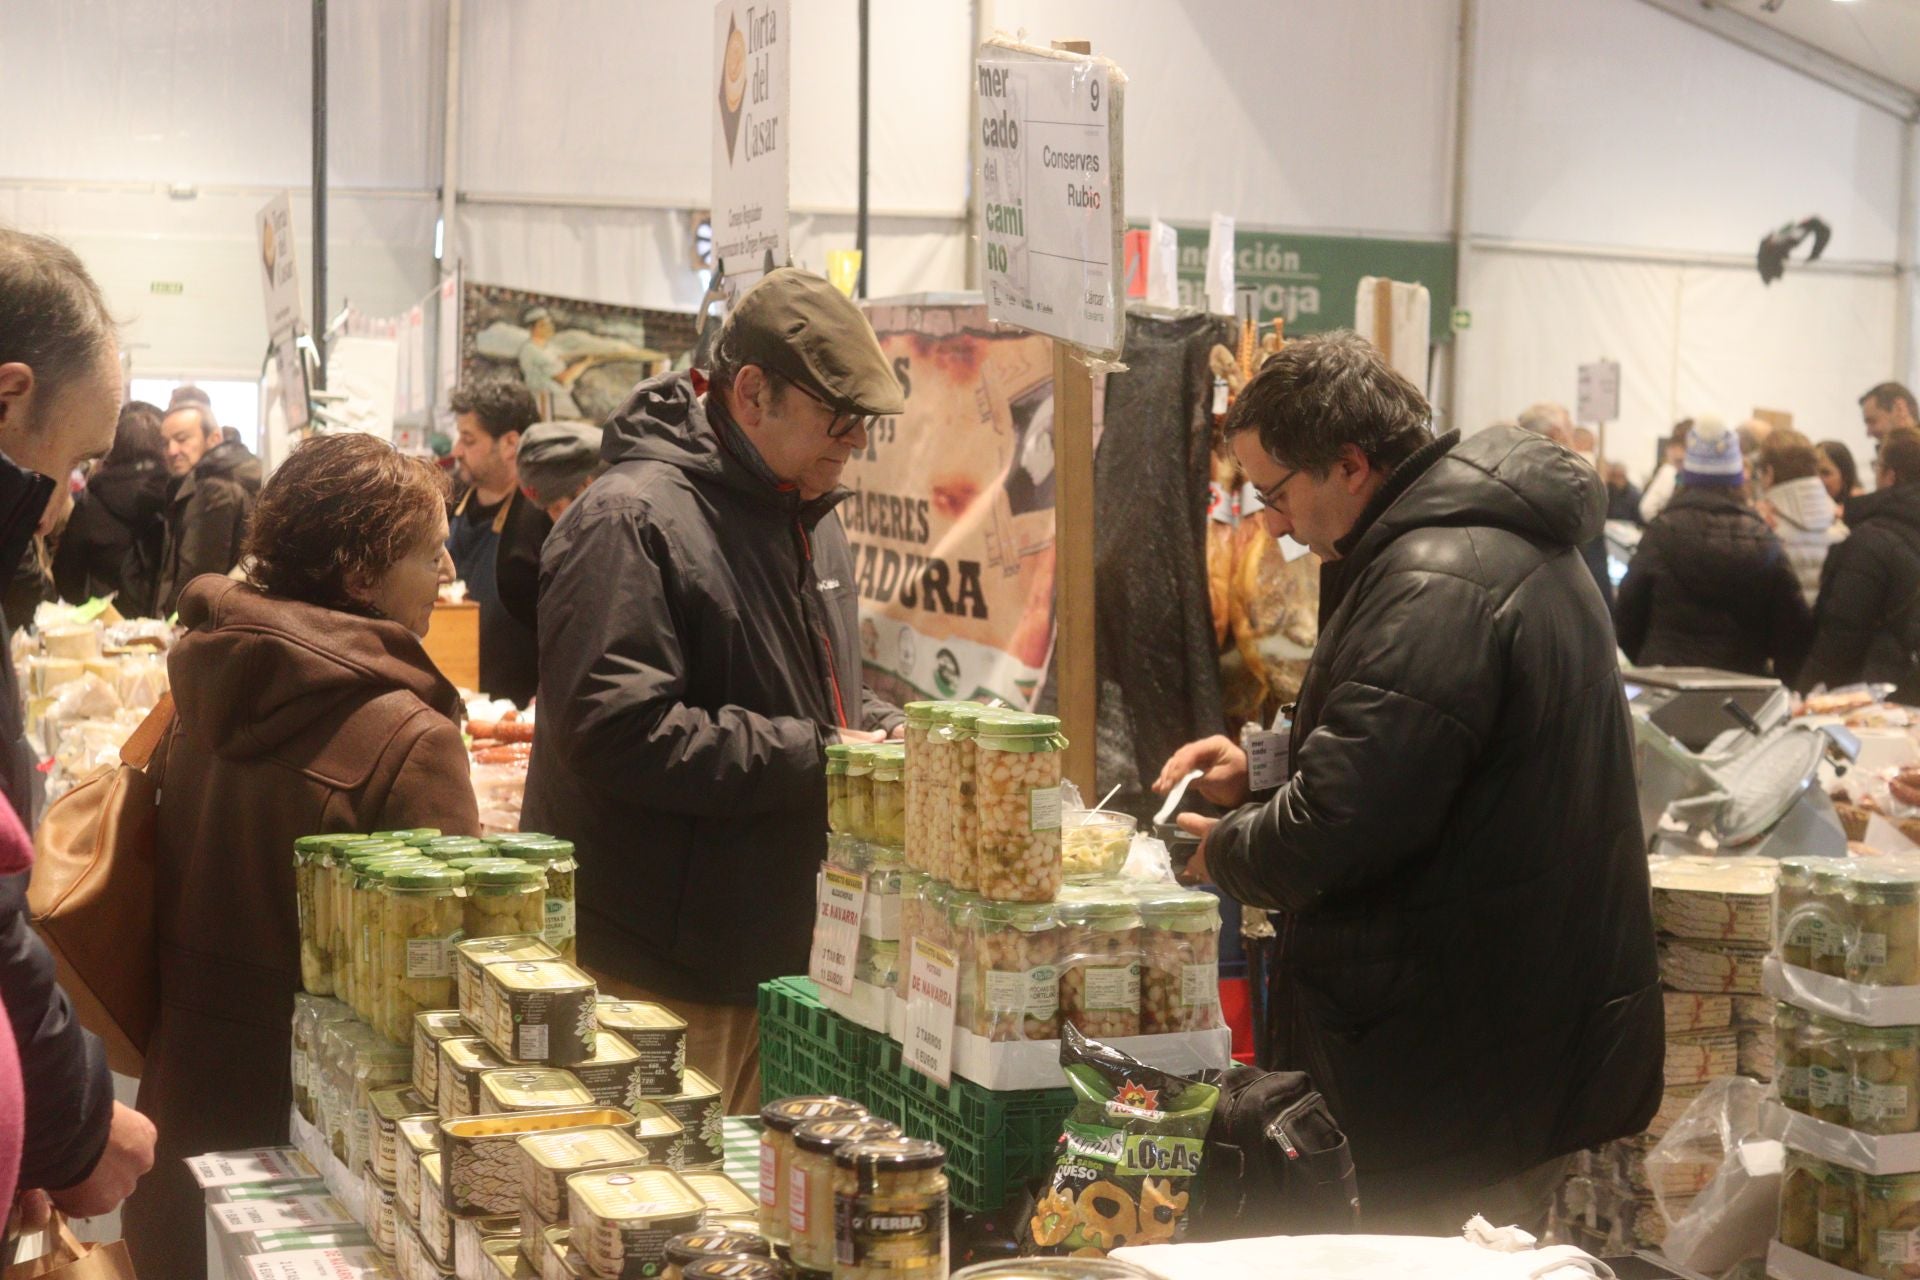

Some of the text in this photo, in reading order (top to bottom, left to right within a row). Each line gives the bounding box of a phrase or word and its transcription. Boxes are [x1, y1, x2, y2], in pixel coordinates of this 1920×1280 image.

[747, 5, 776, 54] Torta
[752, 52, 769, 105] del
[978, 65, 1009, 98] mer
[1090, 79, 1100, 112] 9
[744, 112, 778, 162] Casar
[982, 109, 1018, 149] cado
[984, 157, 998, 182] del
[1043, 144, 1100, 173] Conservas
[1067, 183, 1101, 210] Rubio
[986, 198, 1024, 237] cami
[987, 241, 1008, 274] no
[830, 905, 859, 928] NAVARRA
[912, 974, 952, 1009] DE NAVARRA
[920, 1027, 942, 1051] TARROS
[920, 1051, 938, 1072] EUROS
[1057, 1165, 1097, 1180] QUESO
[1127, 1139, 1201, 1175] LOCAS
[871, 1215, 922, 1230] FERBA
